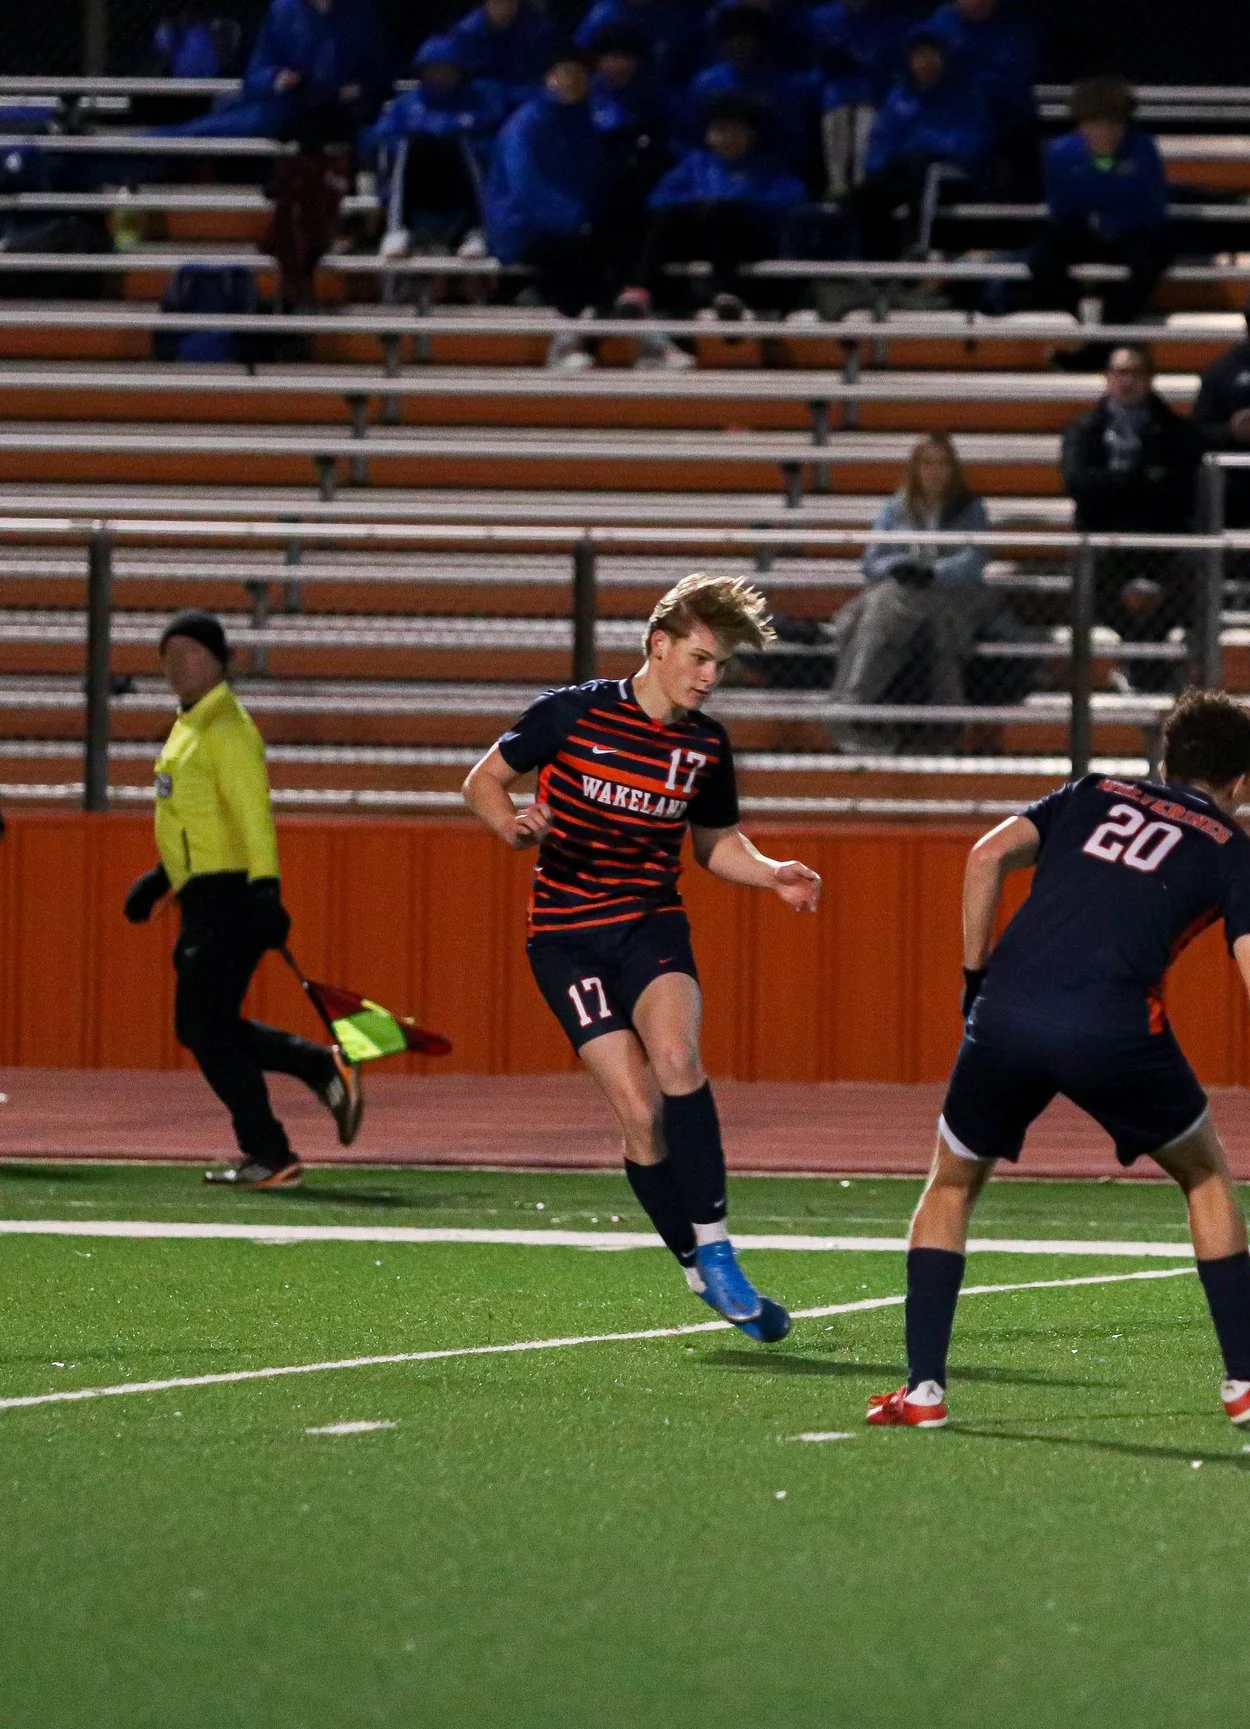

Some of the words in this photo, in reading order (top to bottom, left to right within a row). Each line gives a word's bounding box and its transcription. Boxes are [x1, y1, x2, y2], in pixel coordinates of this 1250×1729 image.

[665, 748, 707, 793] 17
[1083, 803, 1183, 872] 20
[568, 976, 612, 1027] 17
